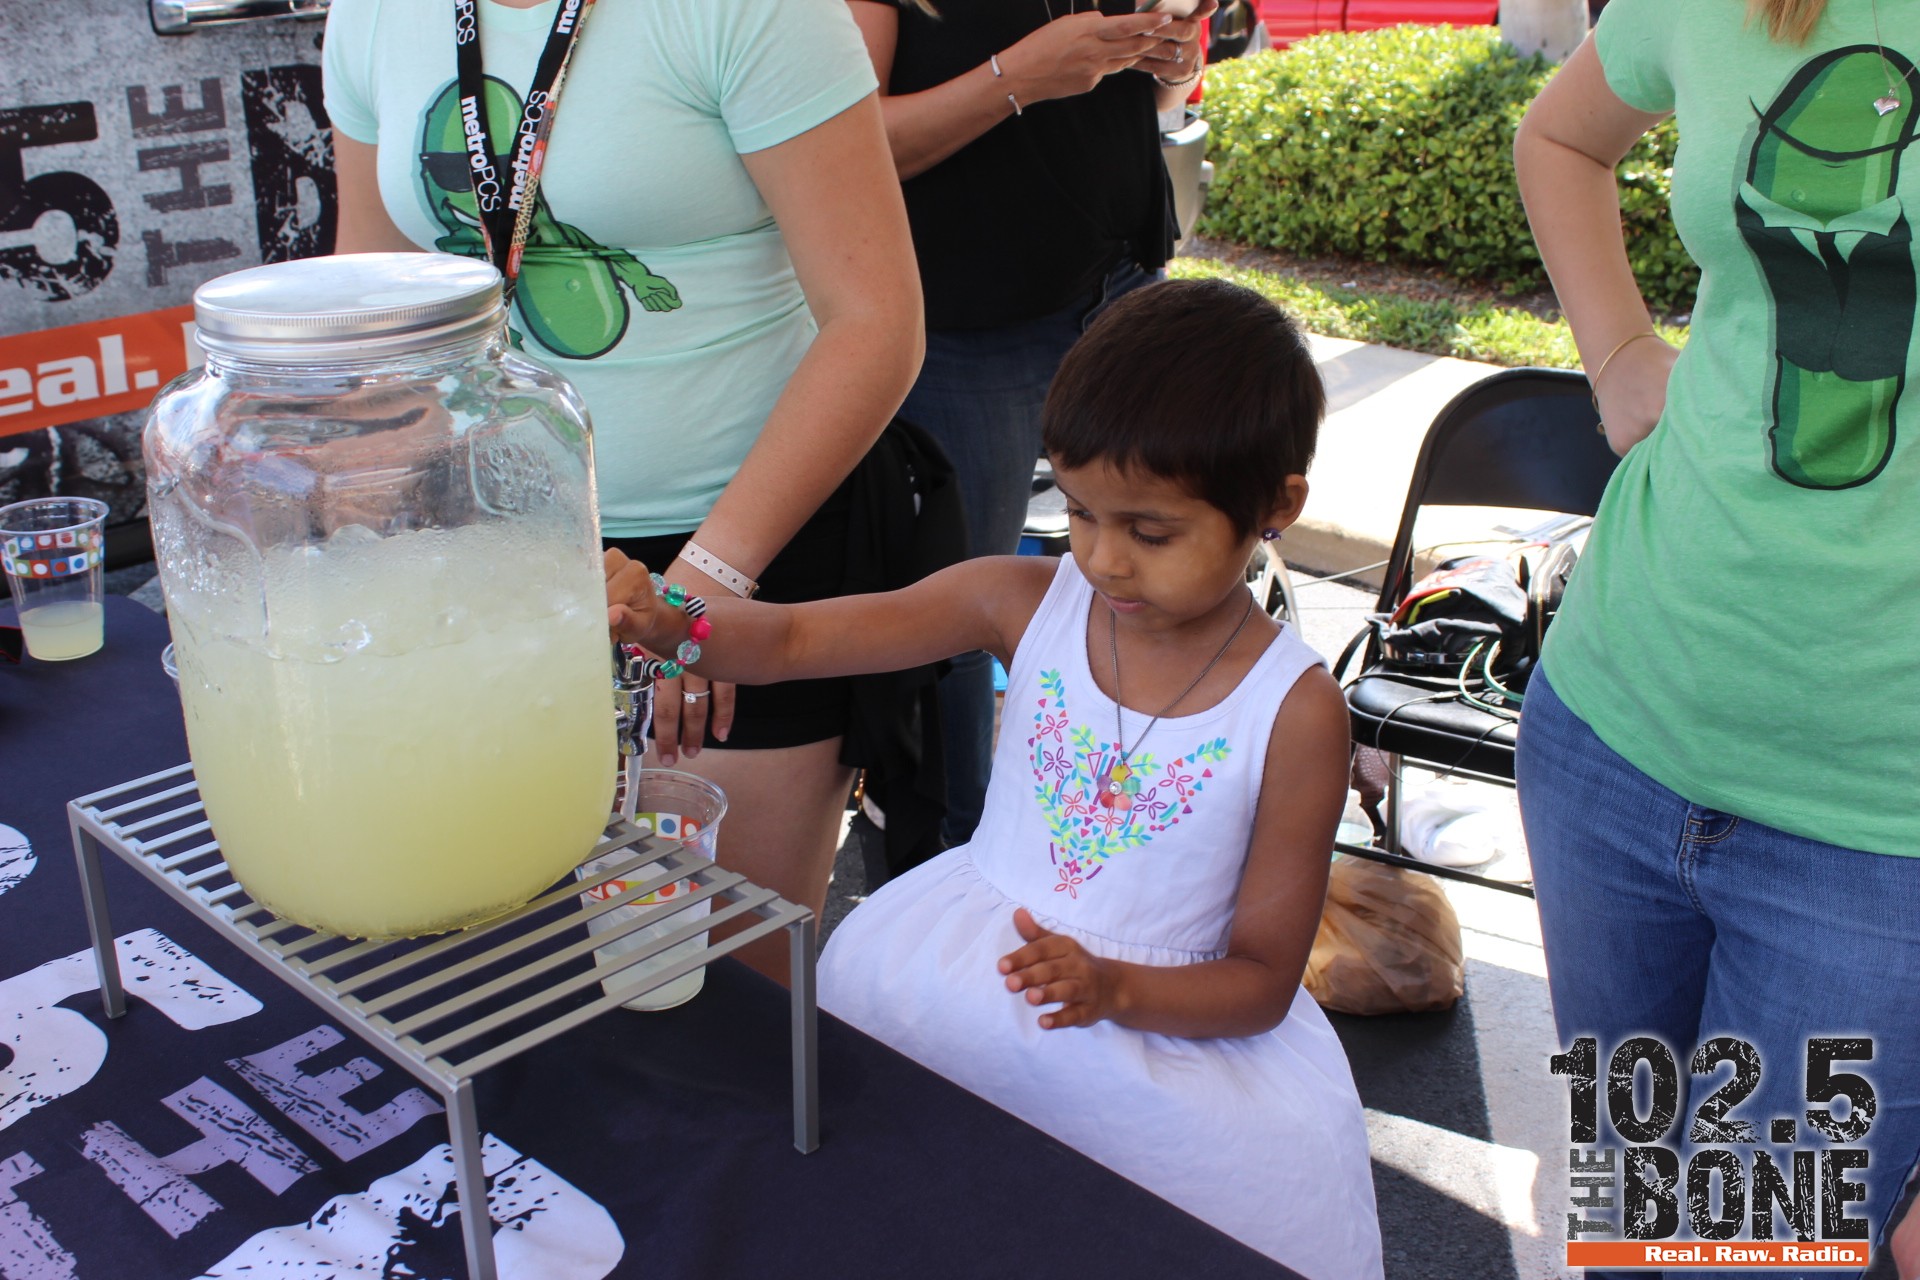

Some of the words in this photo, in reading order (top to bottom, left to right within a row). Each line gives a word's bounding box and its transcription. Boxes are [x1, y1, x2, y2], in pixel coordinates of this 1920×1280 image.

[126, 77, 241, 287] THE
[461, 95, 502, 213] metroPCS
[508, 91, 549, 211] metroPCS
